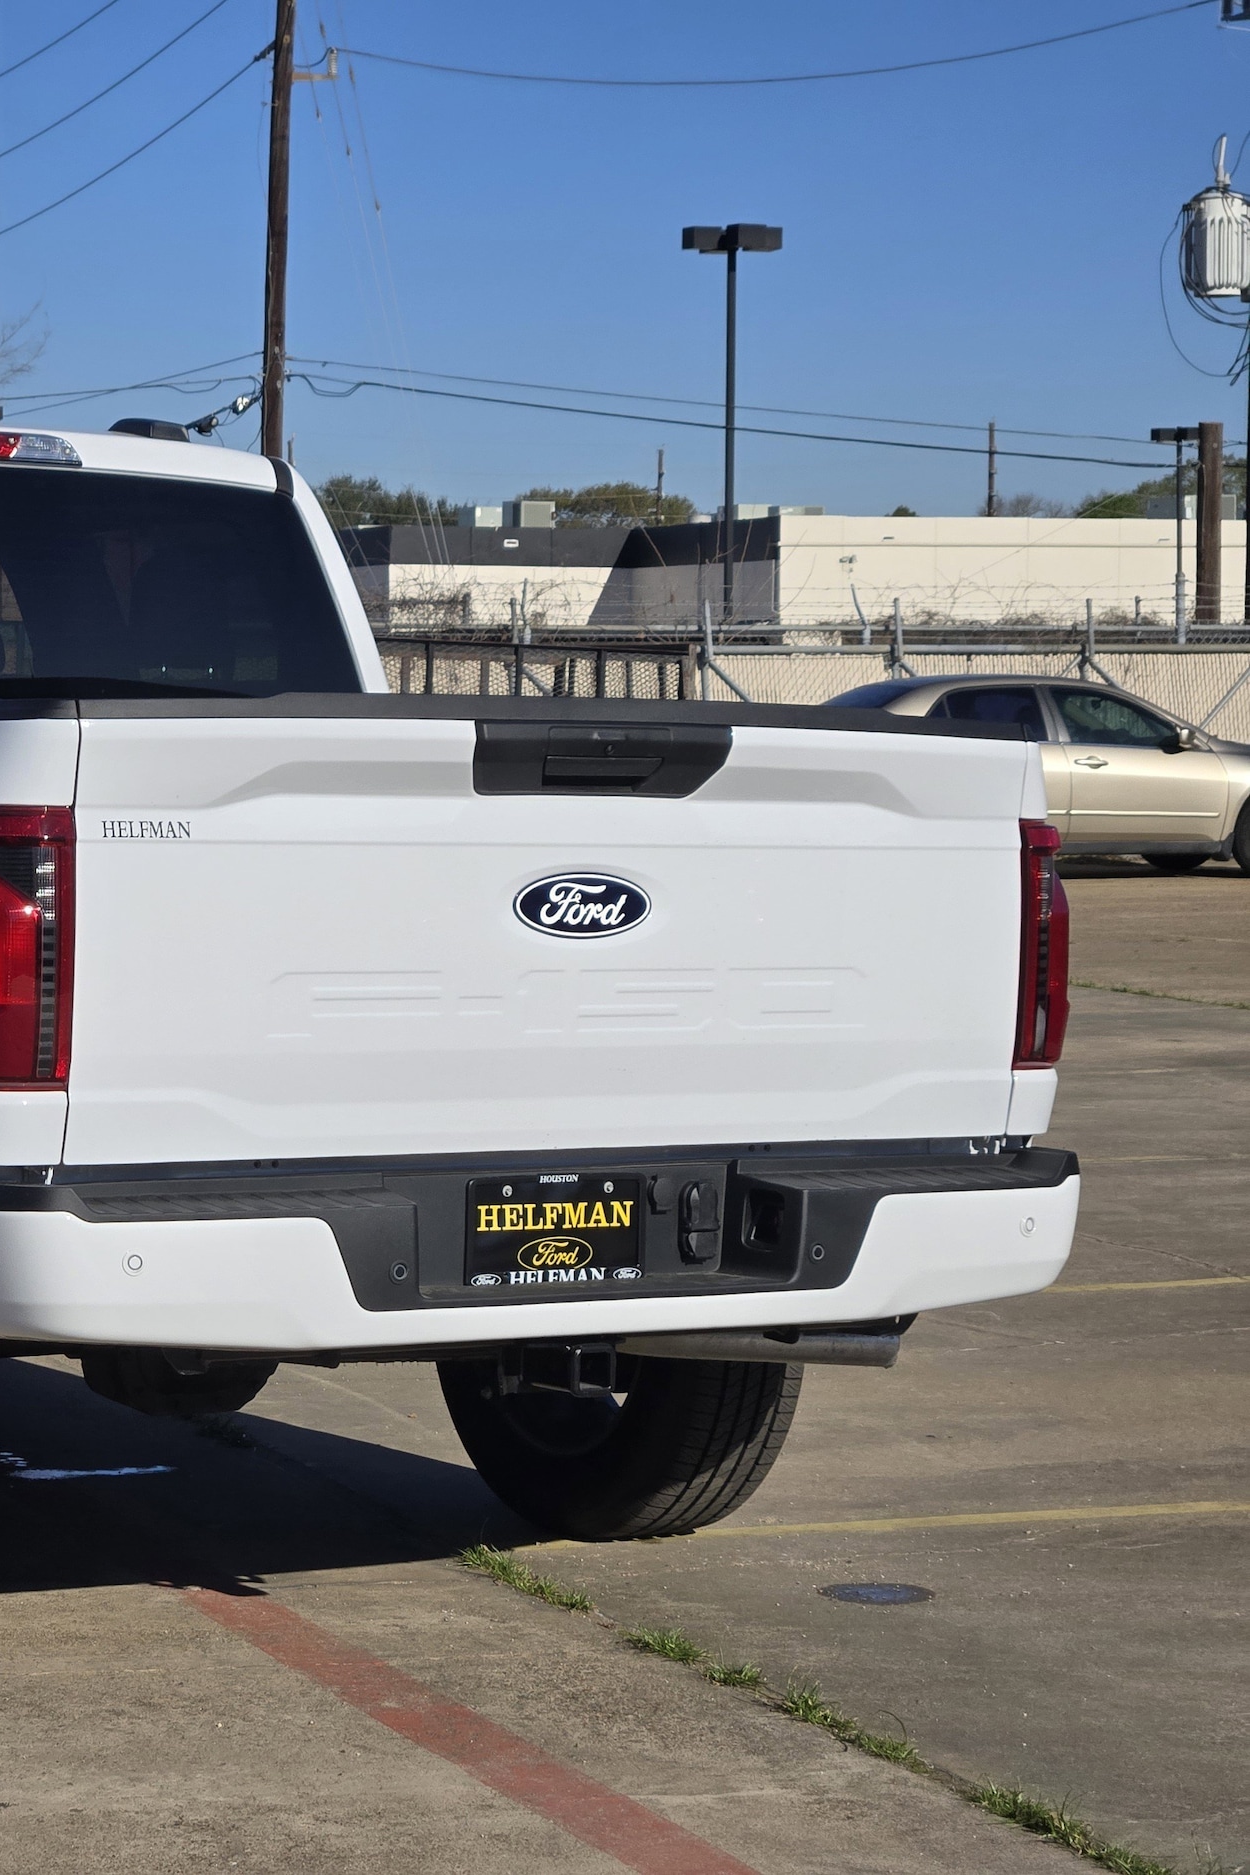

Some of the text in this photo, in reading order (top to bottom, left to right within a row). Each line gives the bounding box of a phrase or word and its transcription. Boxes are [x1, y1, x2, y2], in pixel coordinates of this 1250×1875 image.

[101, 820, 191, 839] HELFMAN
[540, 882, 629, 925] Ford
[539, 1174, 579, 1183] HOUSTON
[476, 1200, 634, 1232] HELFMAN
[532, 1240, 579, 1266] Ford
